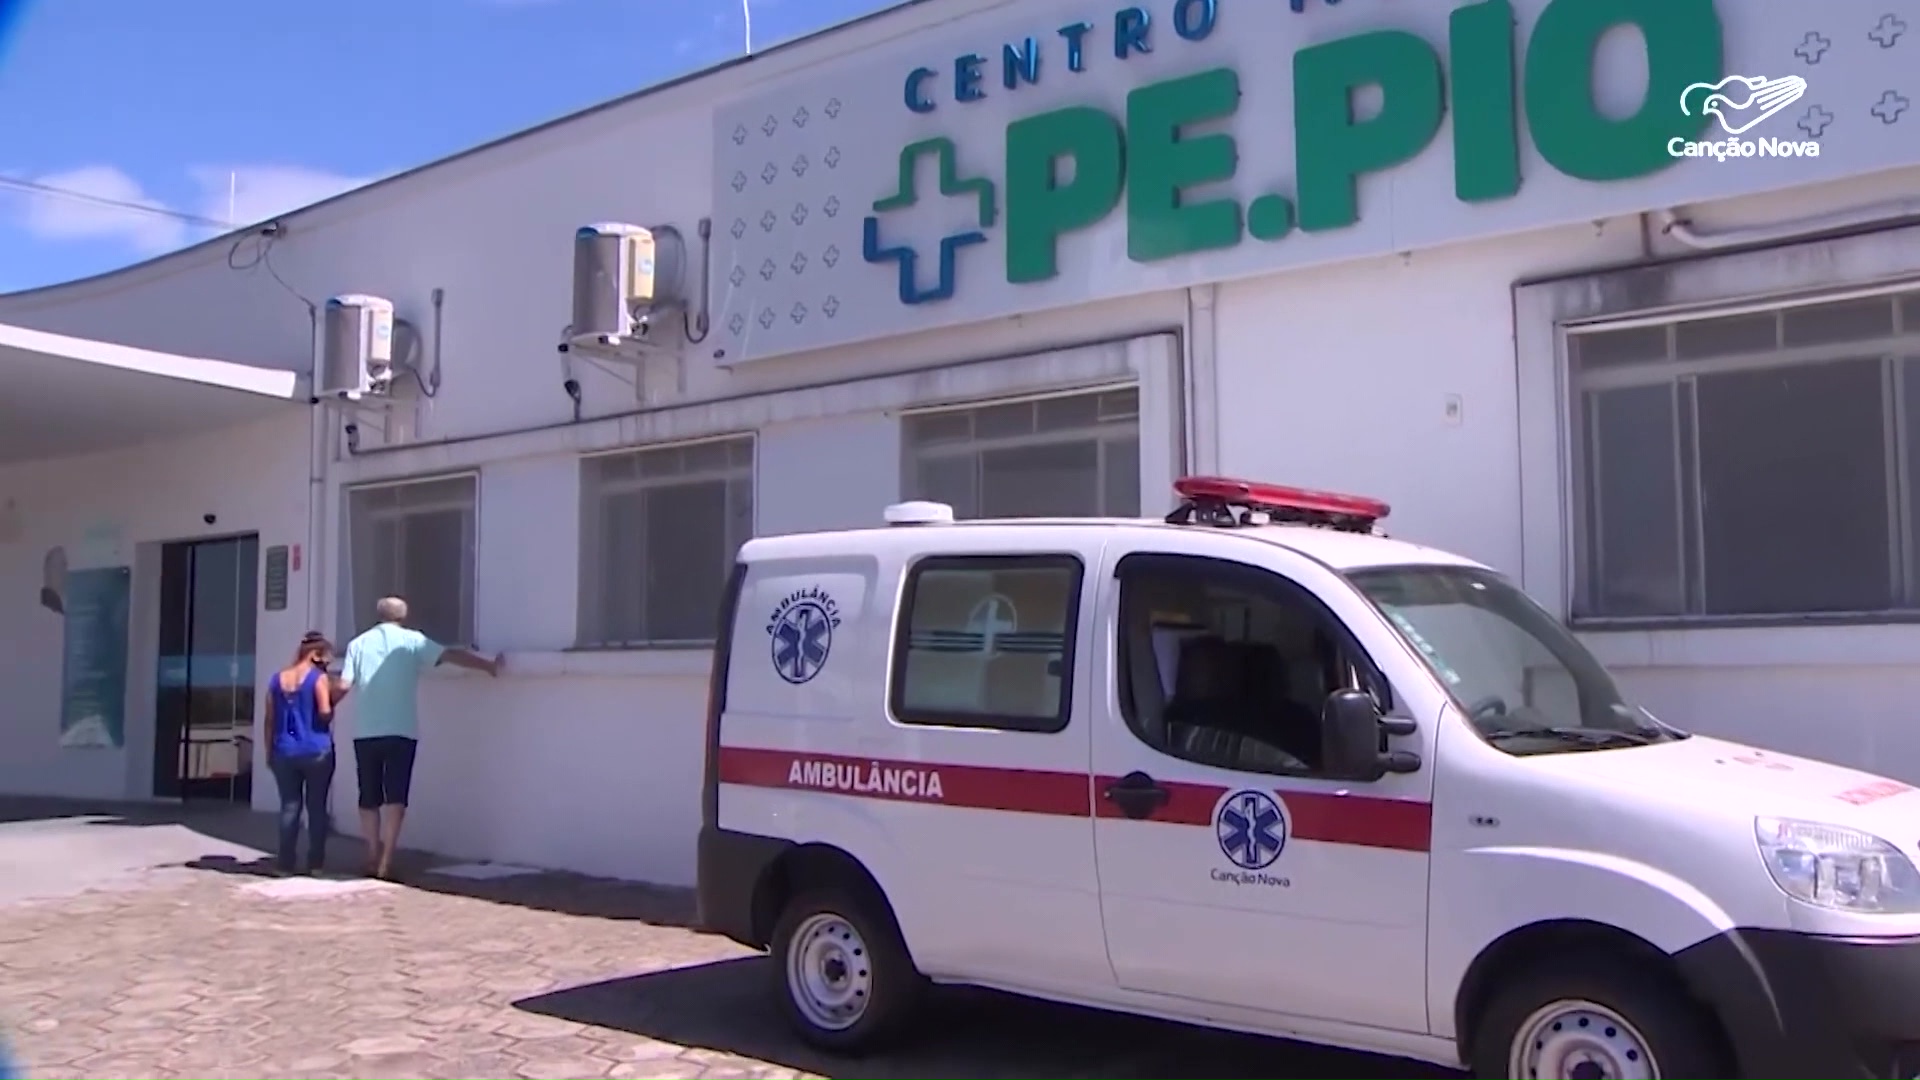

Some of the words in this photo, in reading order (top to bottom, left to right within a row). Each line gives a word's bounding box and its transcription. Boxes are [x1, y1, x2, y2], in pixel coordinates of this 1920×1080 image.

[904, 0, 1217, 114] CENTRO
[788, 760, 944, 798] AMBULÂNCIA
[1210, 868, 1256, 886] Canção
[1257, 873, 1291, 888] Nova
